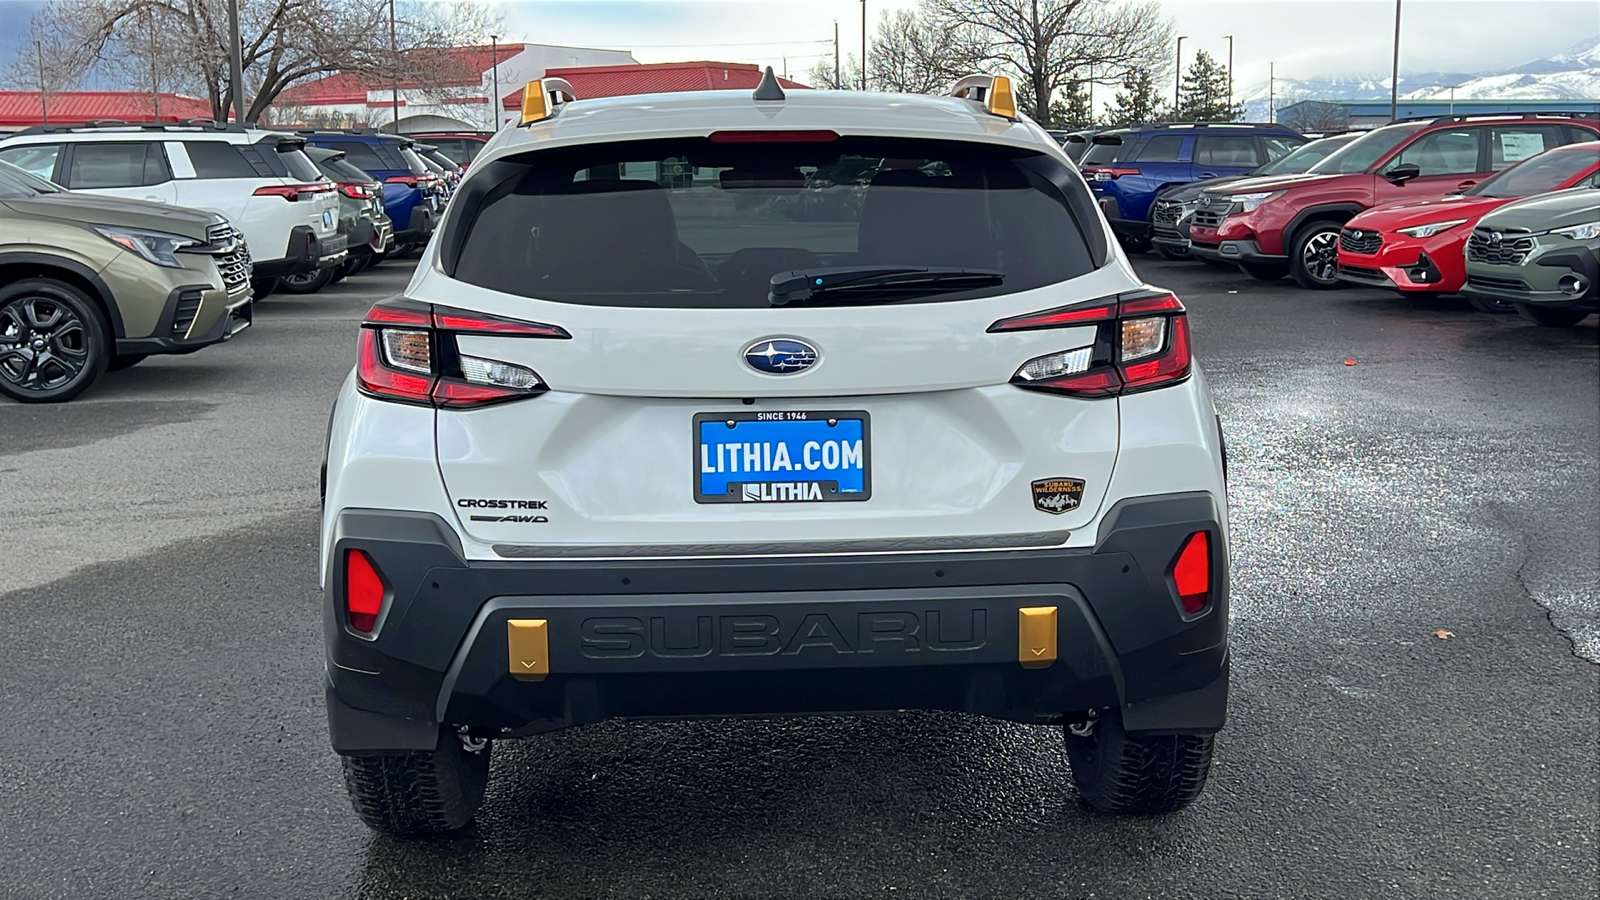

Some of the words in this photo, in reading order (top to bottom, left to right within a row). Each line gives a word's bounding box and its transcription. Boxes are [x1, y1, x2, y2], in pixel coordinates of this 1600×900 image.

[757, 412, 784, 421] SINCE
[786, 412, 807, 420] 1946
[701, 440, 863, 473] LITHIA.COM
[761, 482, 823, 501] LITHIA
[457, 498, 548, 510] CROSSTREK
[499, 515, 549, 523] AWD
[580, 608, 989, 659] SUBARU
